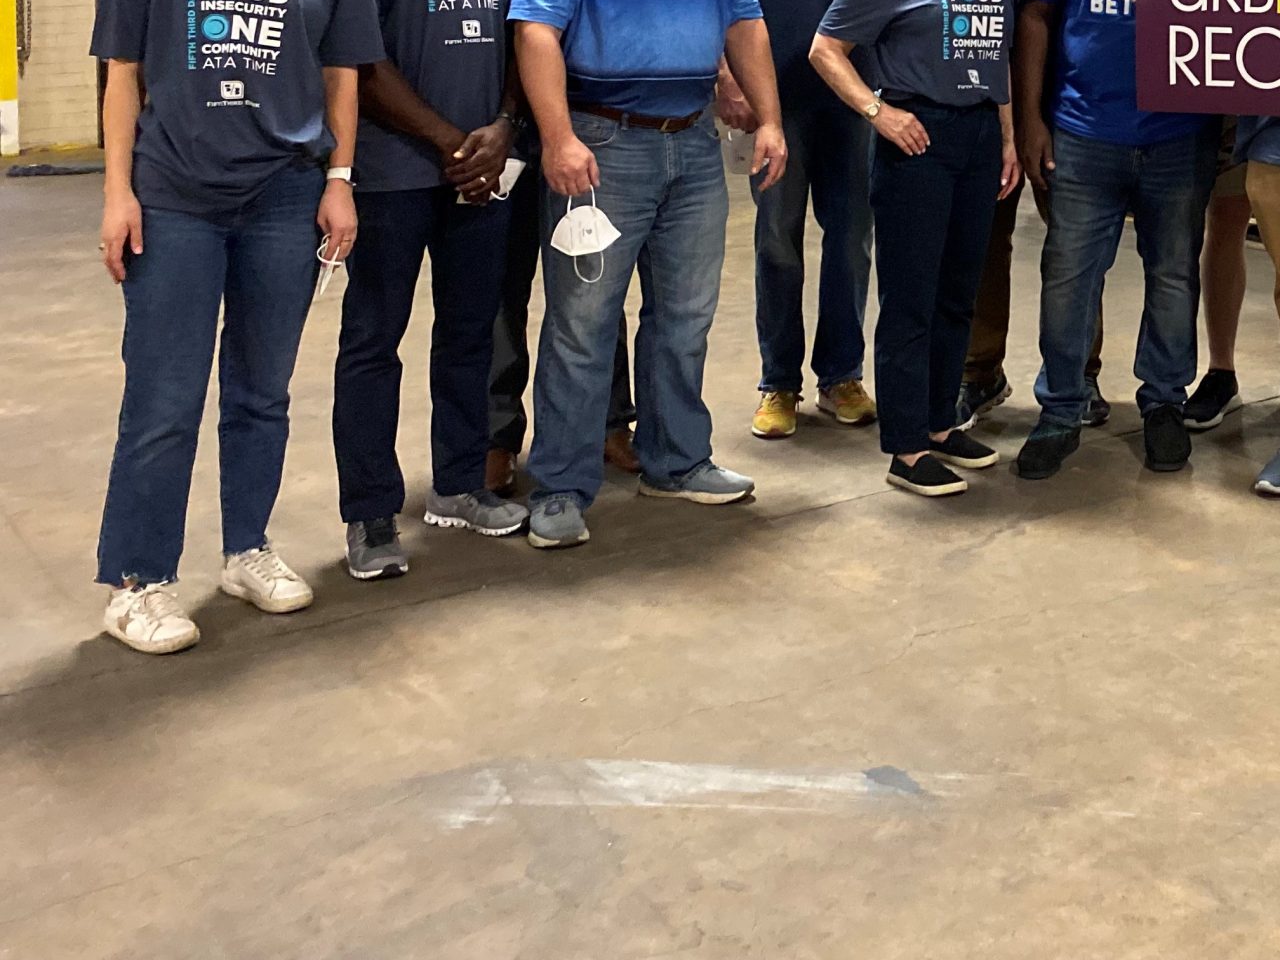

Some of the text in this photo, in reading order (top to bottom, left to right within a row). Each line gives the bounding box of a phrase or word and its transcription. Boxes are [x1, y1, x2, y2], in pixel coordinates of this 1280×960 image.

[200, 0, 287, 18] INSECURITY
[952, 4, 1004, 14] INSECURITY
[187, 10, 197, 39] THIRD
[201, 14, 284, 48] ONE
[952, 15, 1004, 37] ONE
[201, 42, 280, 60] COMMUNITY
[952, 39, 1002, 48] COMMUNITY
[187, 42, 197, 70] FIFTH
[953, 50, 1001, 60] AT A TIME
[202, 57, 277, 75] AT A TIME
